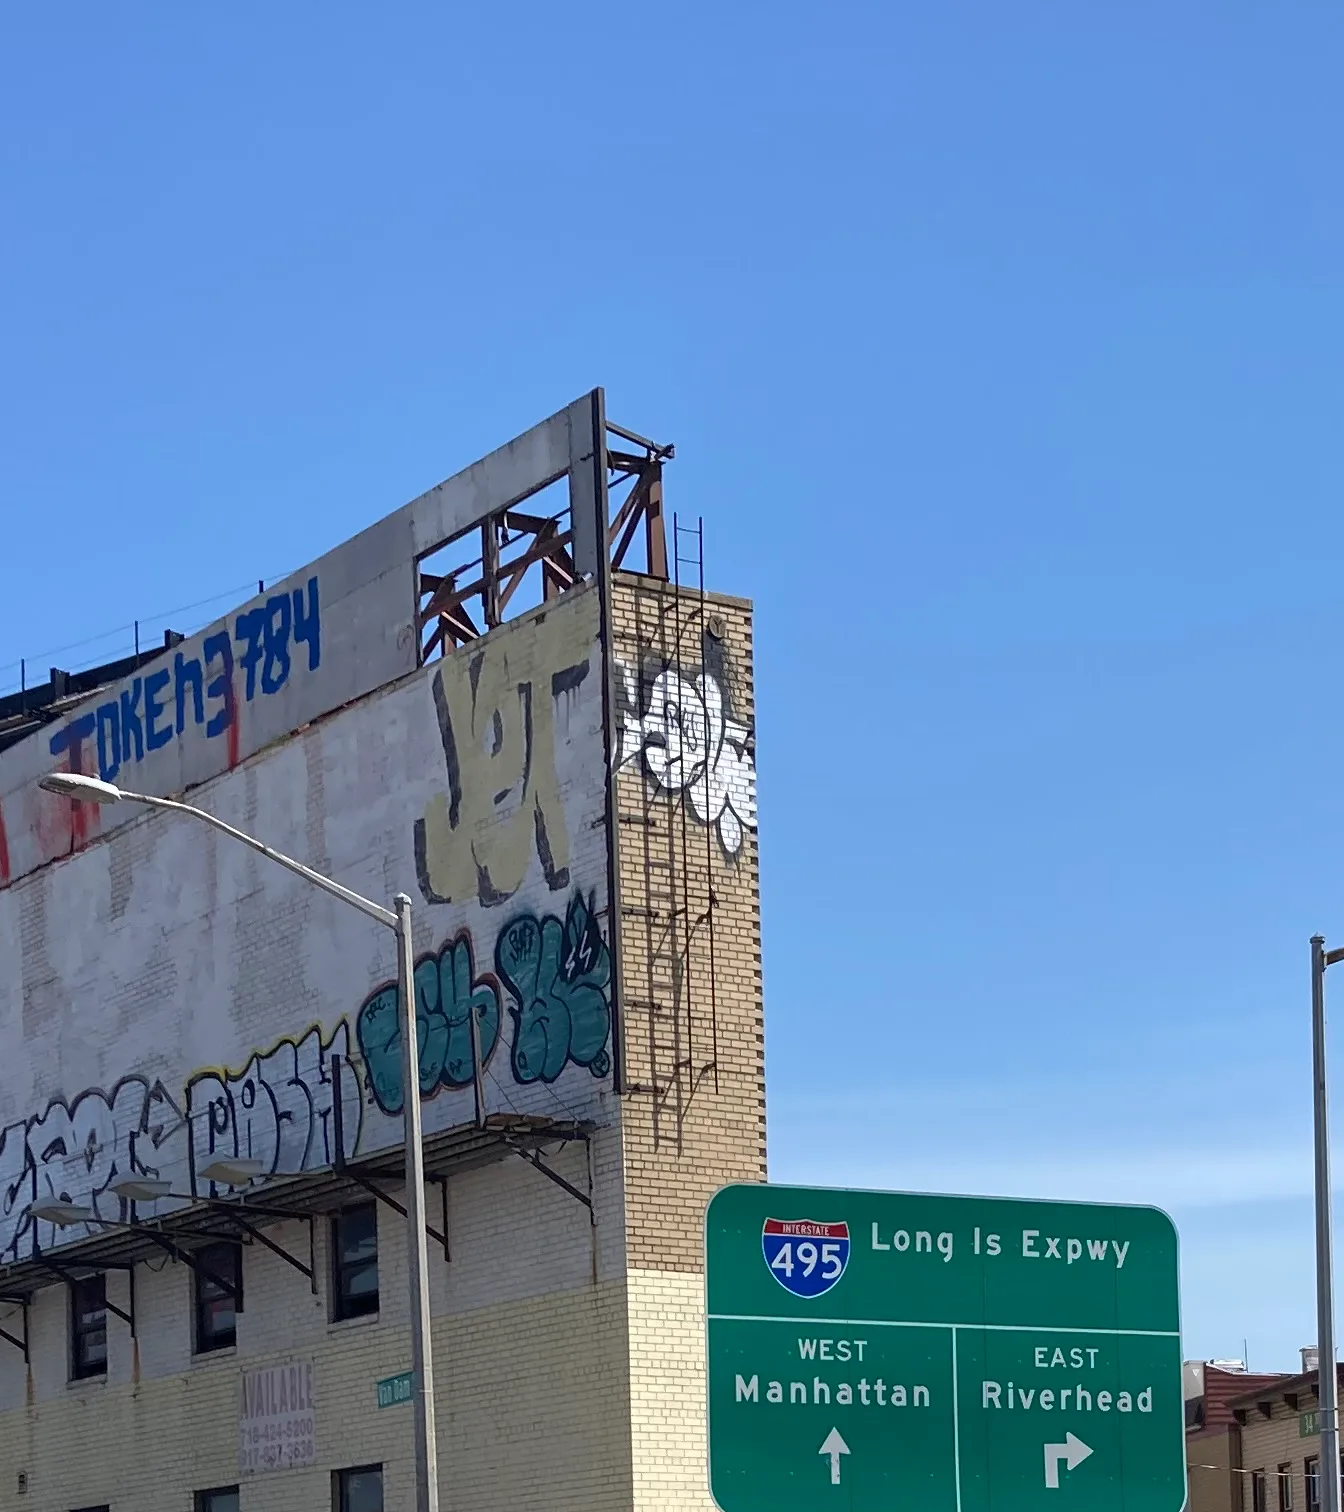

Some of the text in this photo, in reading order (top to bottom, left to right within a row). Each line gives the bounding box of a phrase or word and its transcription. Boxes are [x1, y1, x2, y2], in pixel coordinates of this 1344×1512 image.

[782, 1223, 830, 1236] INTERSTATE
[871, 1222, 1130, 1268] Long Is Expwy
[771, 1242, 842, 1279] 495
[798, 1339, 867, 1361] WEST
[1035, 1347, 1099, 1369] EAST
[242, 1363, 313, 1420] AVAILABLE
[379, 1378, 410, 1404] Van Dam
[735, 1374, 930, 1406] Manhattan
[982, 1381, 1153, 1412] Riverhead
